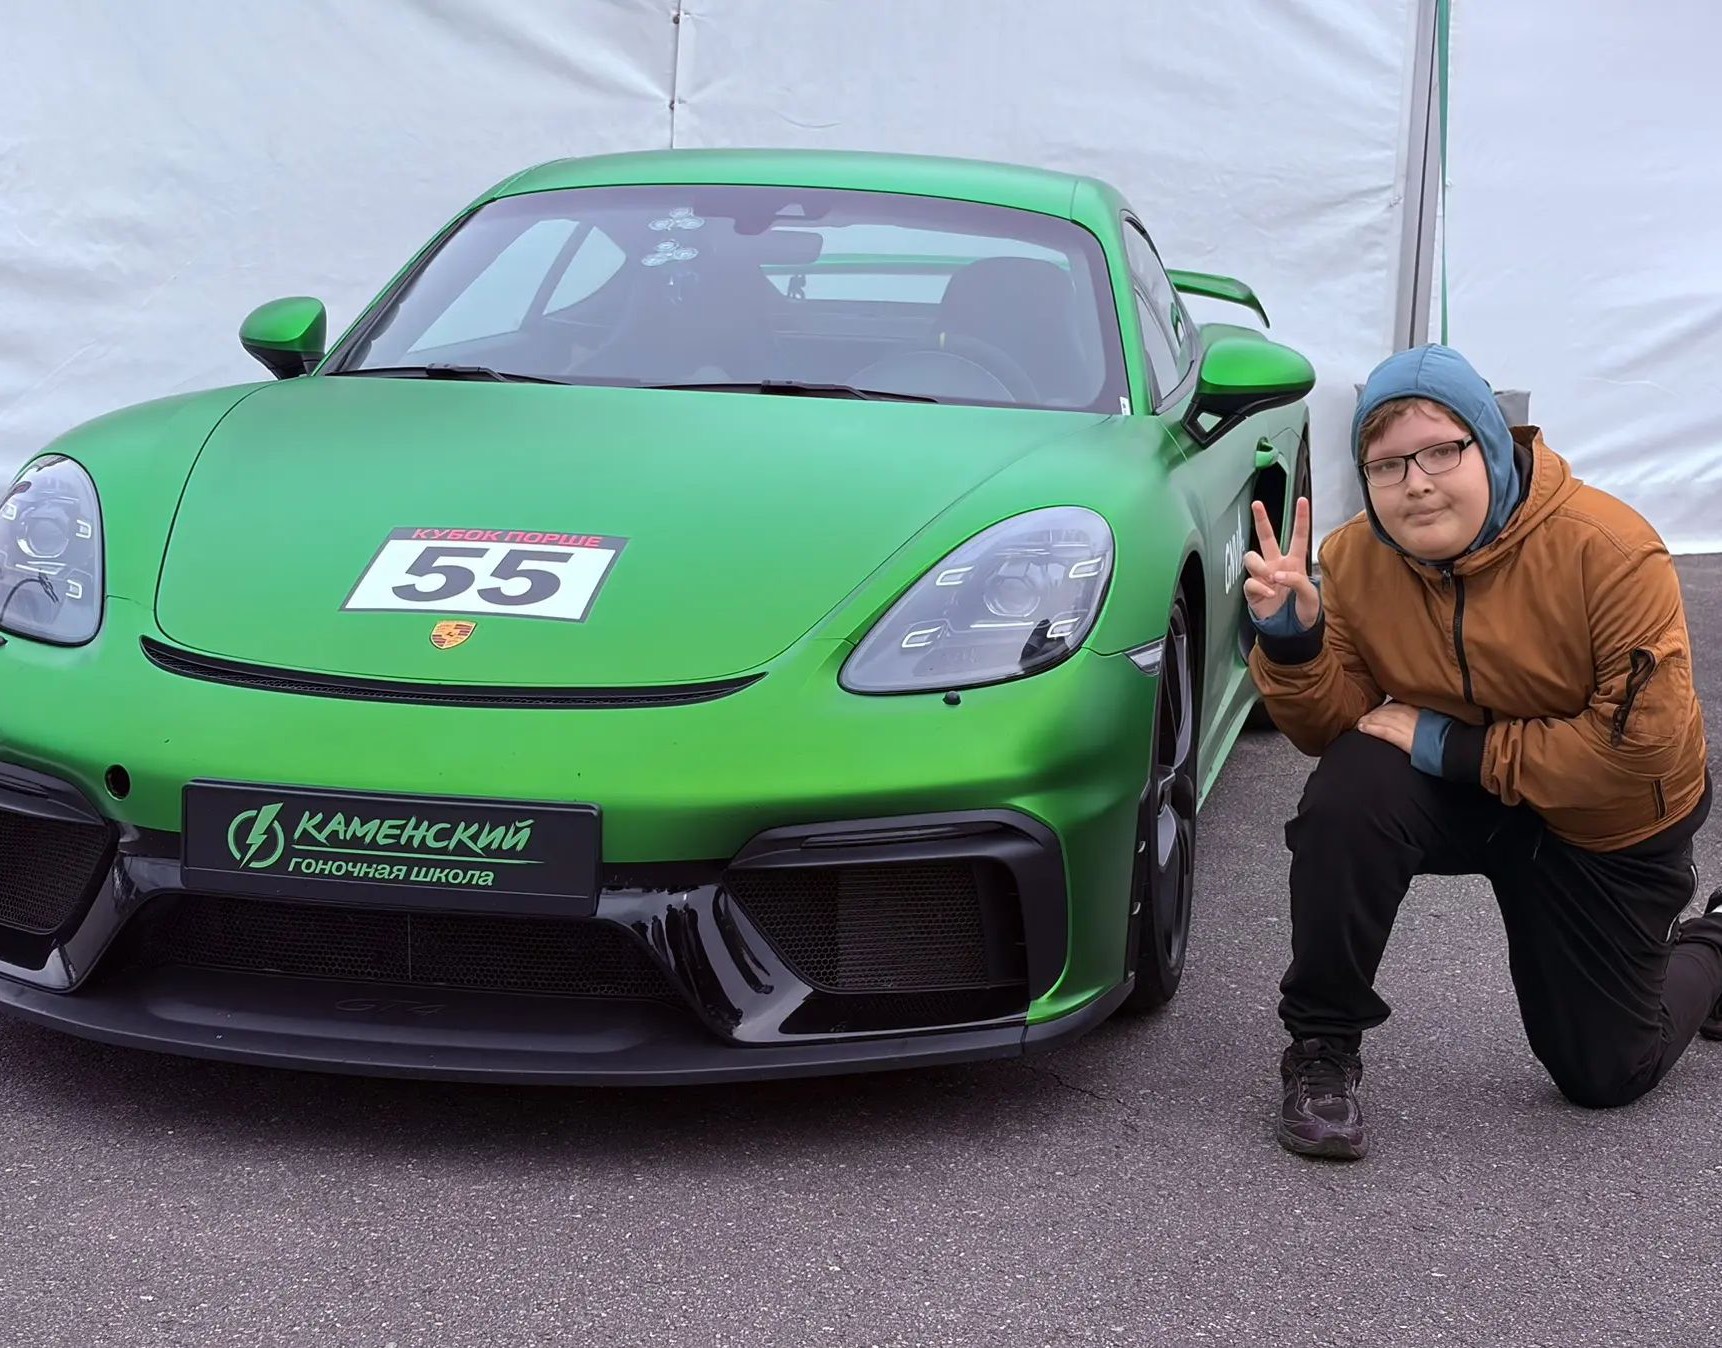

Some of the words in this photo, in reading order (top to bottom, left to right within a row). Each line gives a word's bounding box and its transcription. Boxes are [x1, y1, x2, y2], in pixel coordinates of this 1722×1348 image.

[412, 528, 501, 543] КУБОК
[504, 529, 602, 548] ПОРШЕ
[391, 546, 575, 606] 55
[293, 810, 535, 857] КАМЕНСКИЙ
